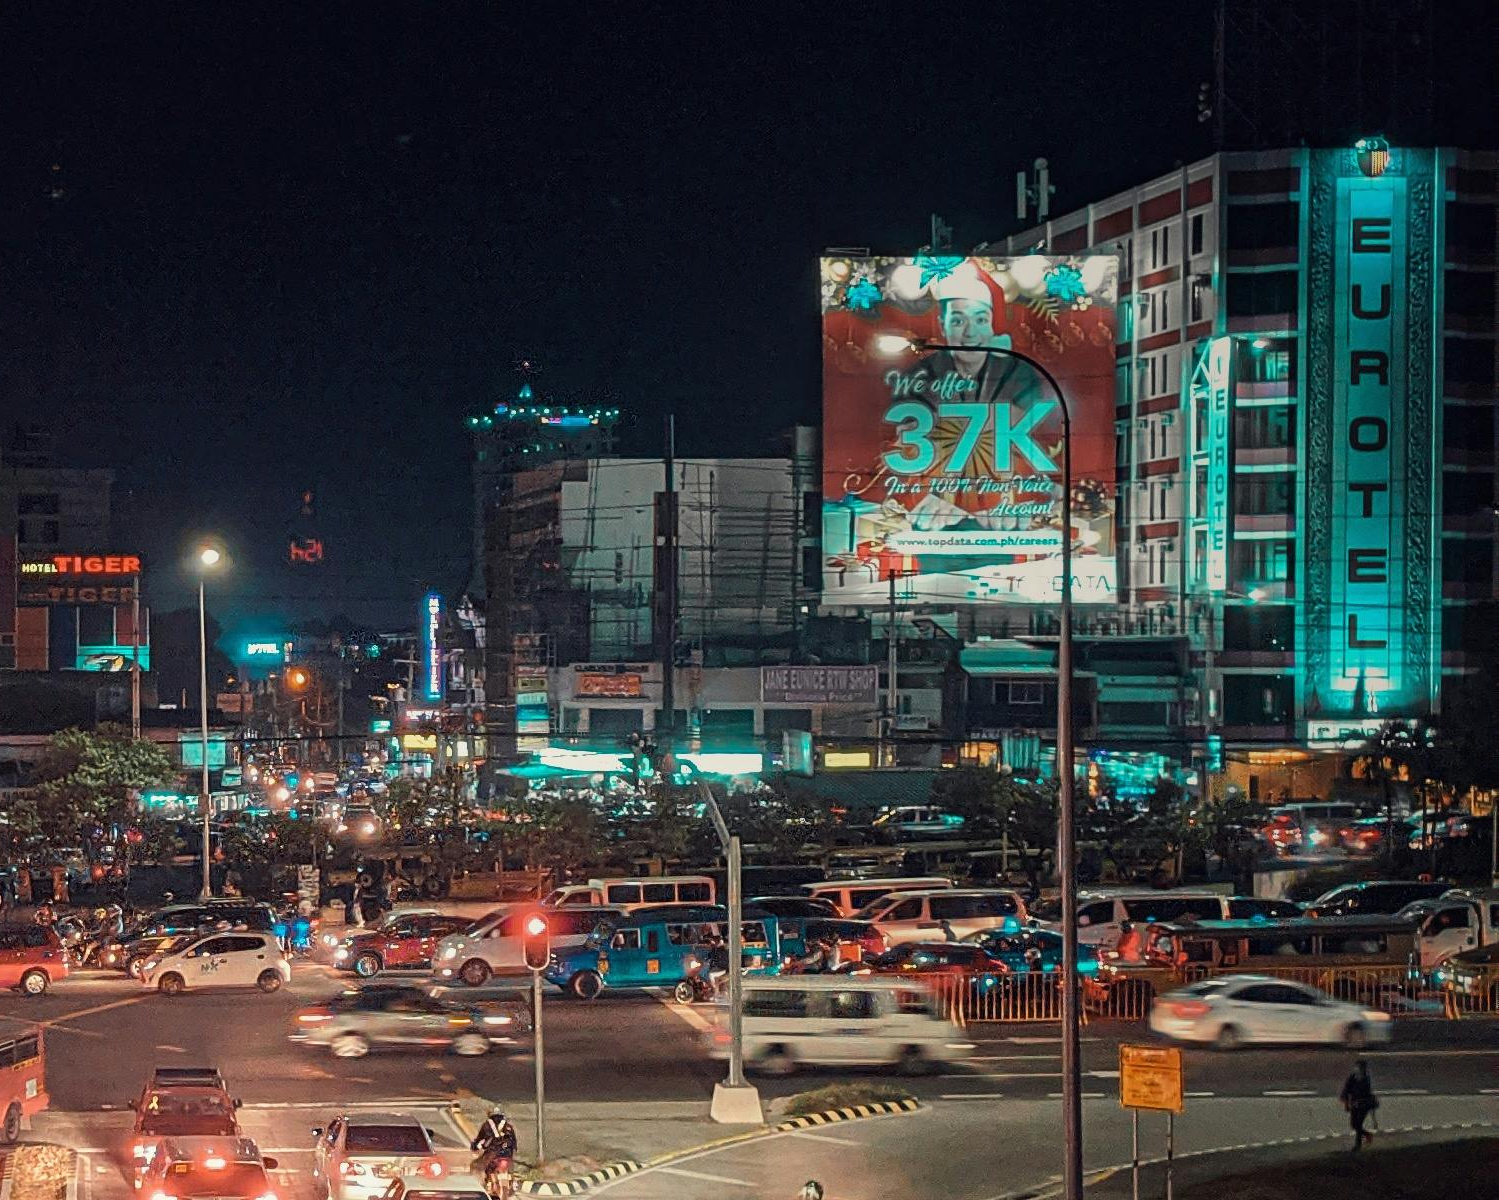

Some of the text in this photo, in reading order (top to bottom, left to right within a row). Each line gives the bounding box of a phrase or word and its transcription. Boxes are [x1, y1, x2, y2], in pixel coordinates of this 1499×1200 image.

[885, 369, 977, 399] We offer
[884, 401, 1060, 473] 37K
[1348, 218, 1391, 649] EUROTEL
[884, 476, 906, 496] In
[910, 483, 921, 493] a
[929, 478, 972, 494] 100%
[988, 500, 1055, 516] Account
[897, 536, 1059, 548] www.topdata.com.ph/careers
[21, 556, 140, 573] HOTEL TIGER
[765, 670, 788, 689] JANE
[791, 670, 825, 689] EUNICE
[849, 670, 875, 689] SHOP
